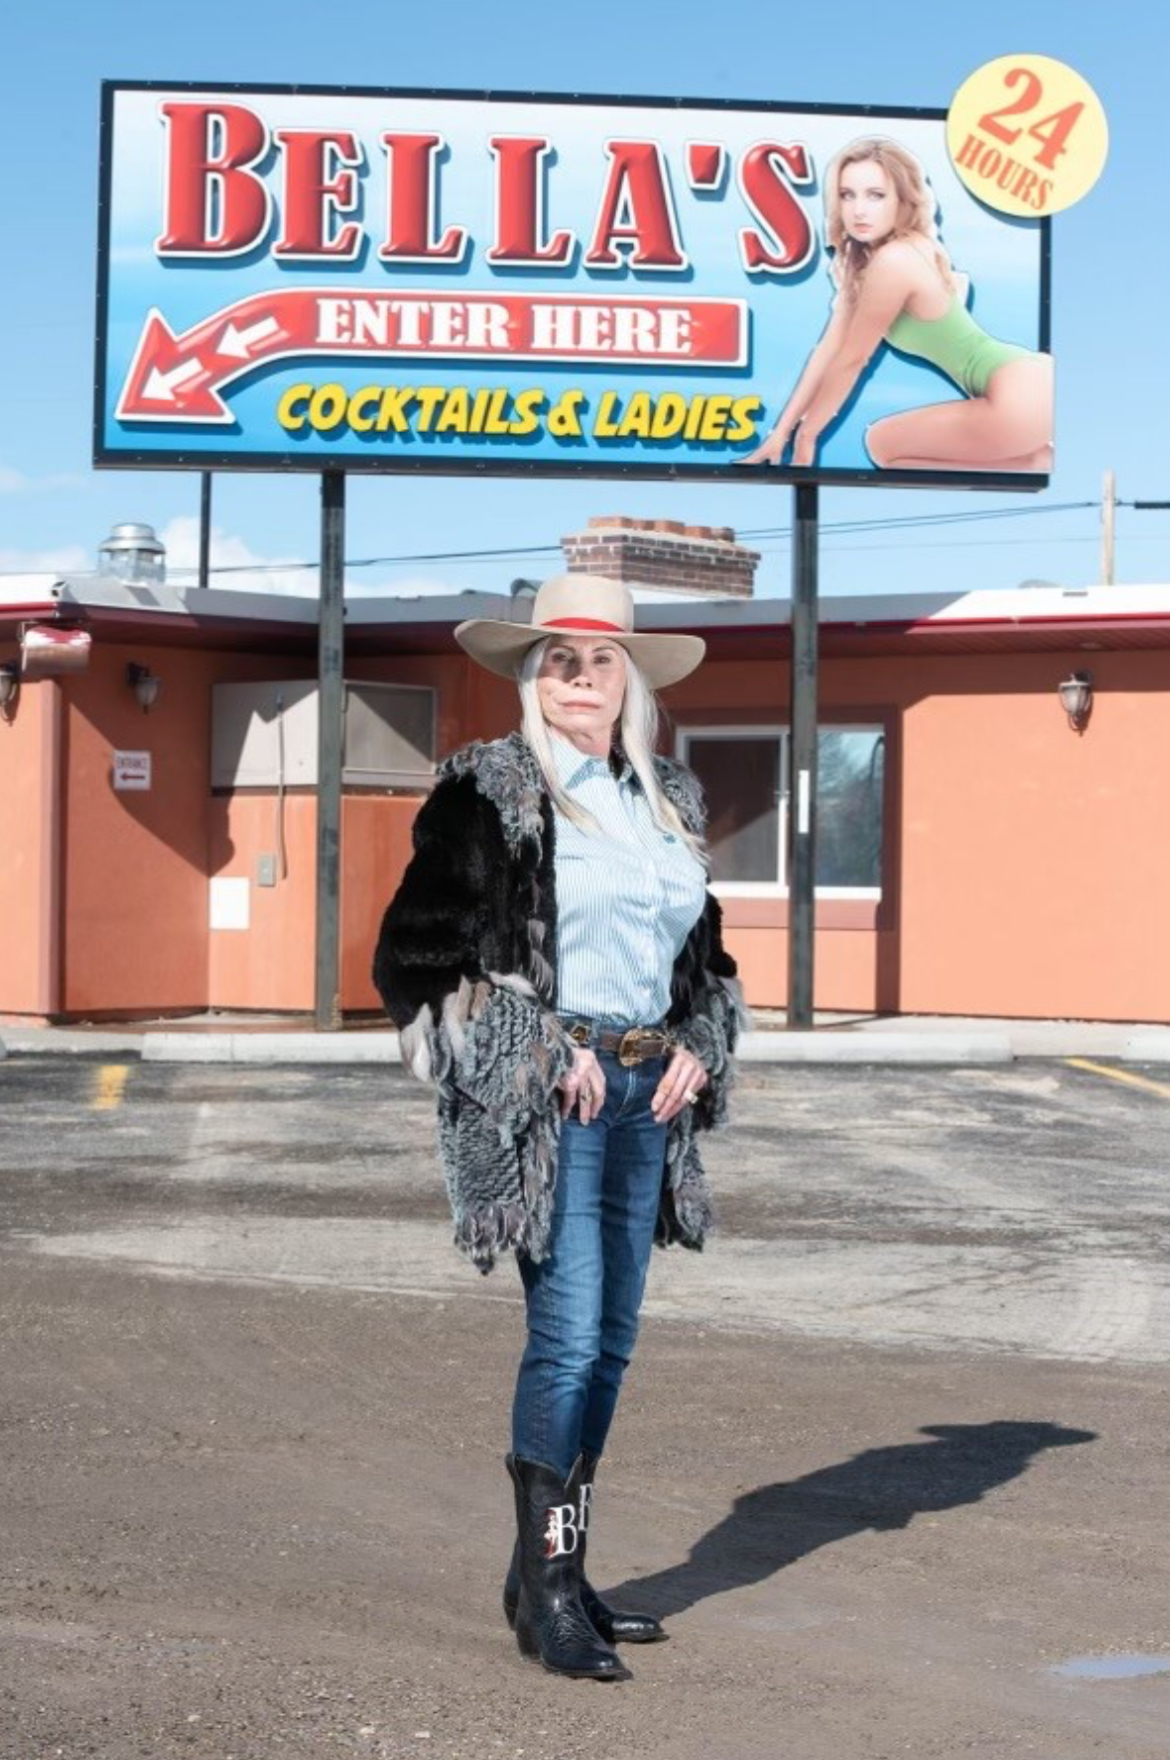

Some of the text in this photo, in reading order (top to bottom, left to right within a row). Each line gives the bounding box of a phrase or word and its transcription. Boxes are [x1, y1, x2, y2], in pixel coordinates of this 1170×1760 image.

[977, 67, 1086, 171] 24
[155, 100, 814, 273] BELLA'S
[955, 134, 1054, 212] HOURS
[315, 297, 693, 355] ENTER HERE
[277, 383, 762, 442] COCKTAILS & LADIES
[547, 1504, 578, 1558] B
